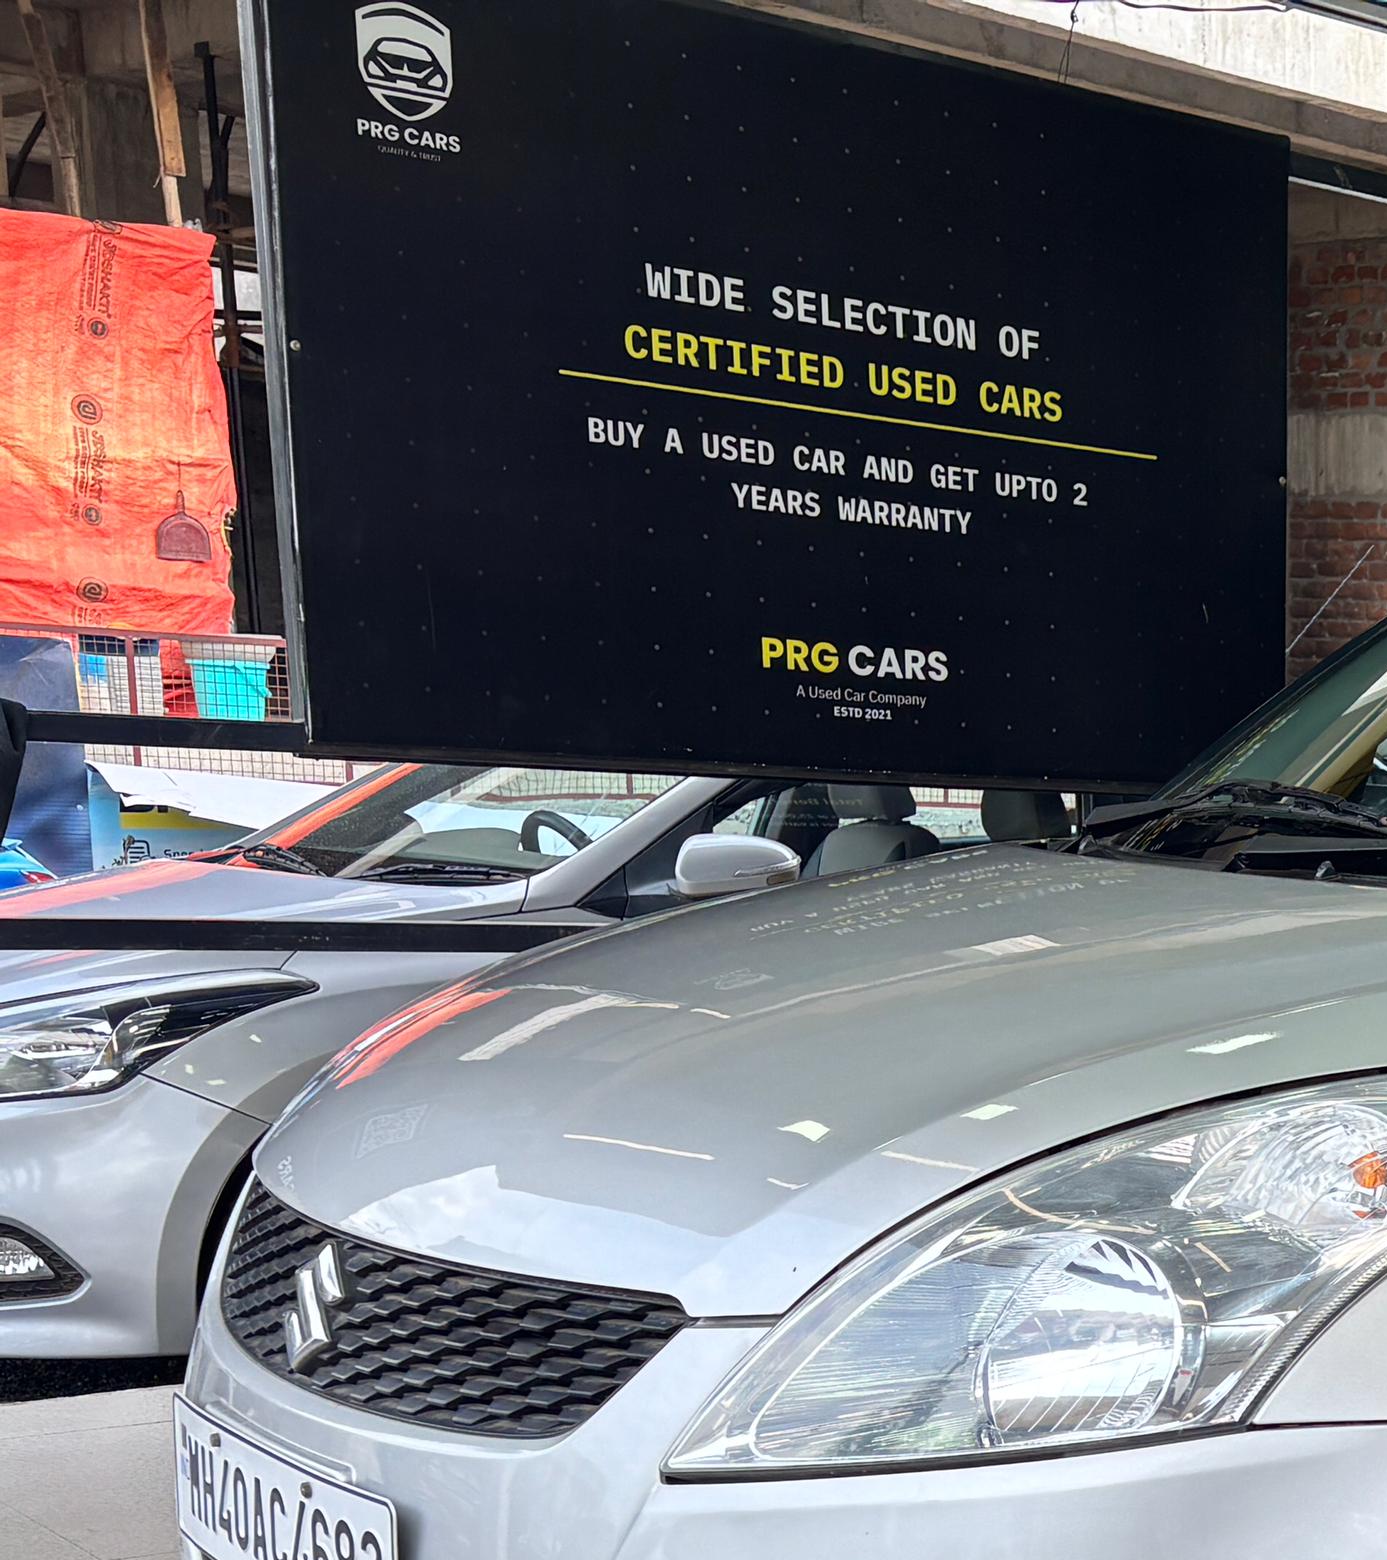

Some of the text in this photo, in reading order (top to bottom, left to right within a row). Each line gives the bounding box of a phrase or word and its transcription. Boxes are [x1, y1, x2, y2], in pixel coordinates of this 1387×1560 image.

[356, 118, 461, 153] PRG CARS
[644, 262, 1040, 360] WIDE SELECTION OF
[624, 324, 1063, 422] CERTIFIED USED CARS
[587, 416, 1088, 506] BUY A USED CAR AND GET UPTO 2
[730, 482, 972, 535] YEARS WARRANTY
[761, 636, 949, 682] PRG CARS
[796, 684, 927, 709] A Used Car Company
[834, 706, 893, 721] ESTD 2021
